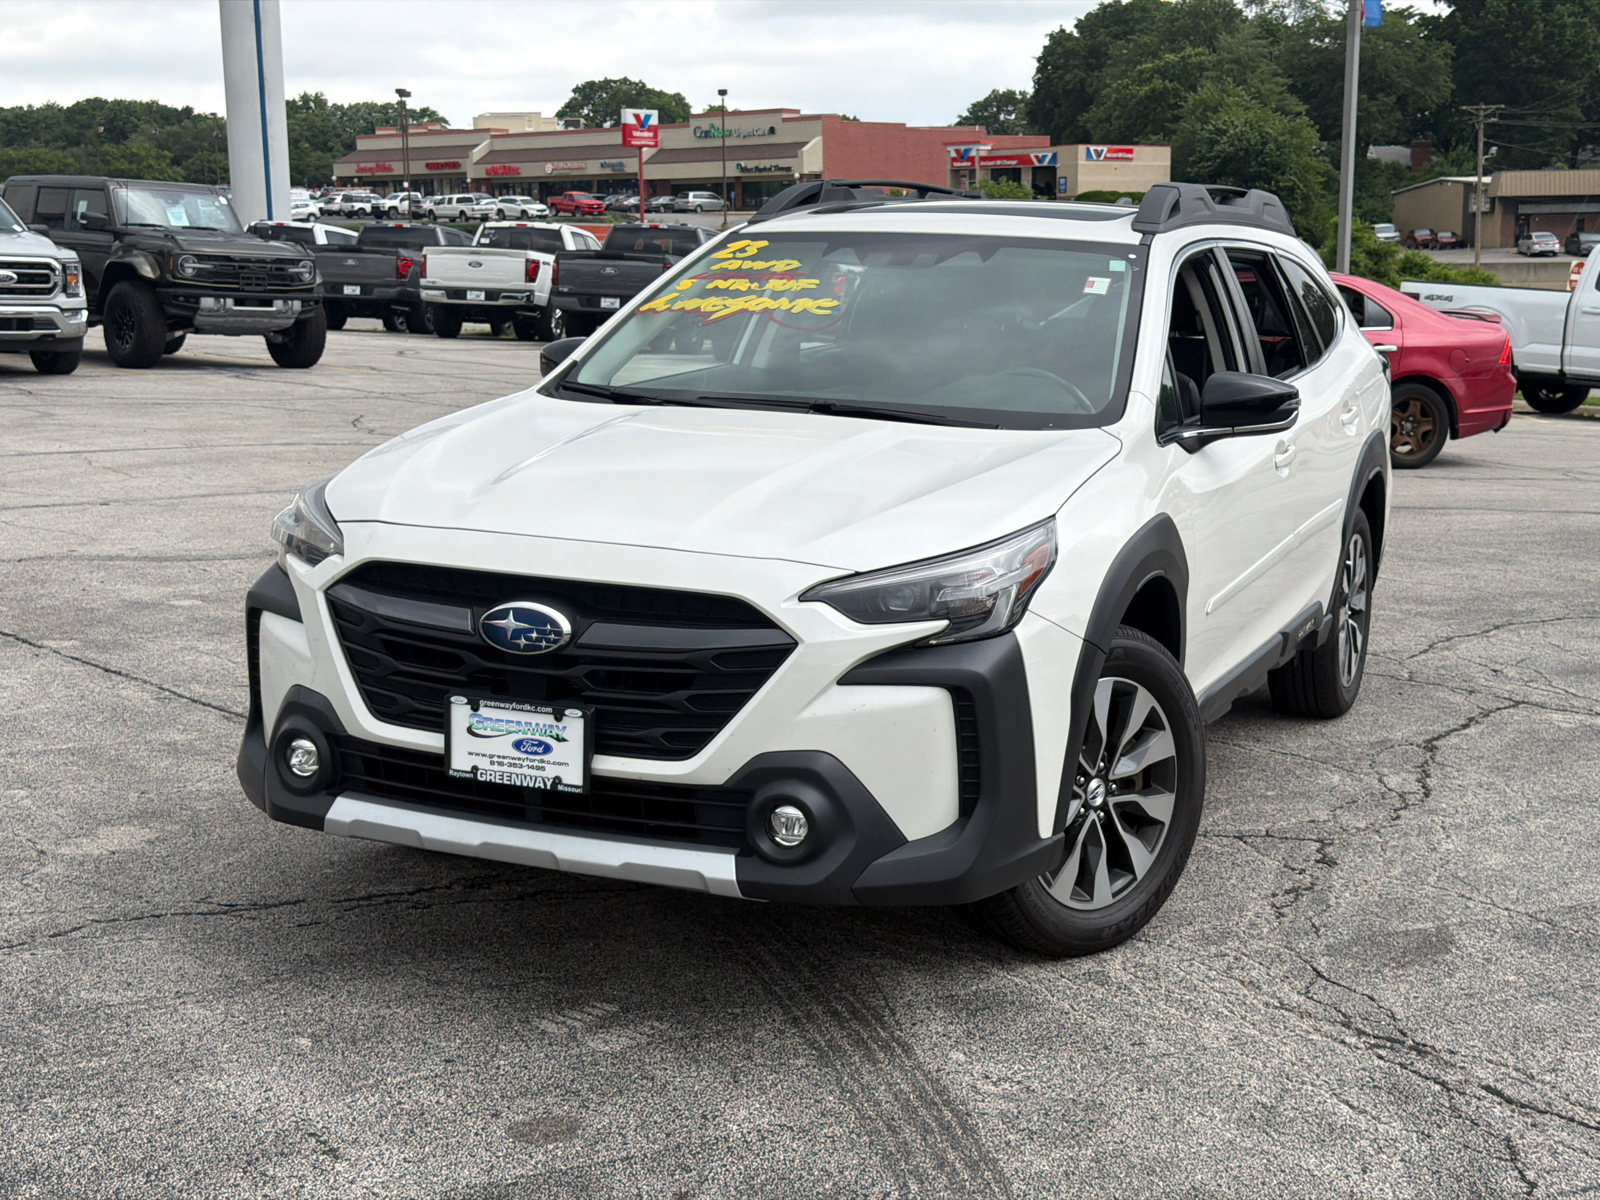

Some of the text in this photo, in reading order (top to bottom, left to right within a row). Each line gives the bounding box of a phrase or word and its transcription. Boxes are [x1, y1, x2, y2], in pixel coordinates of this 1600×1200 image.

[710, 240, 770, 258] 23
[710, 260, 802, 272] AWD
[479, 699, 553, 713] greenwayfordkc.com
[520, 740, 545, 753] Ford
[468, 750, 569, 767] www.greenwayfordkc.com
[490, 760, 546, 771] 816-353-1495
[449, 768, 583, 793] Raytown GREENWAY Missouri
